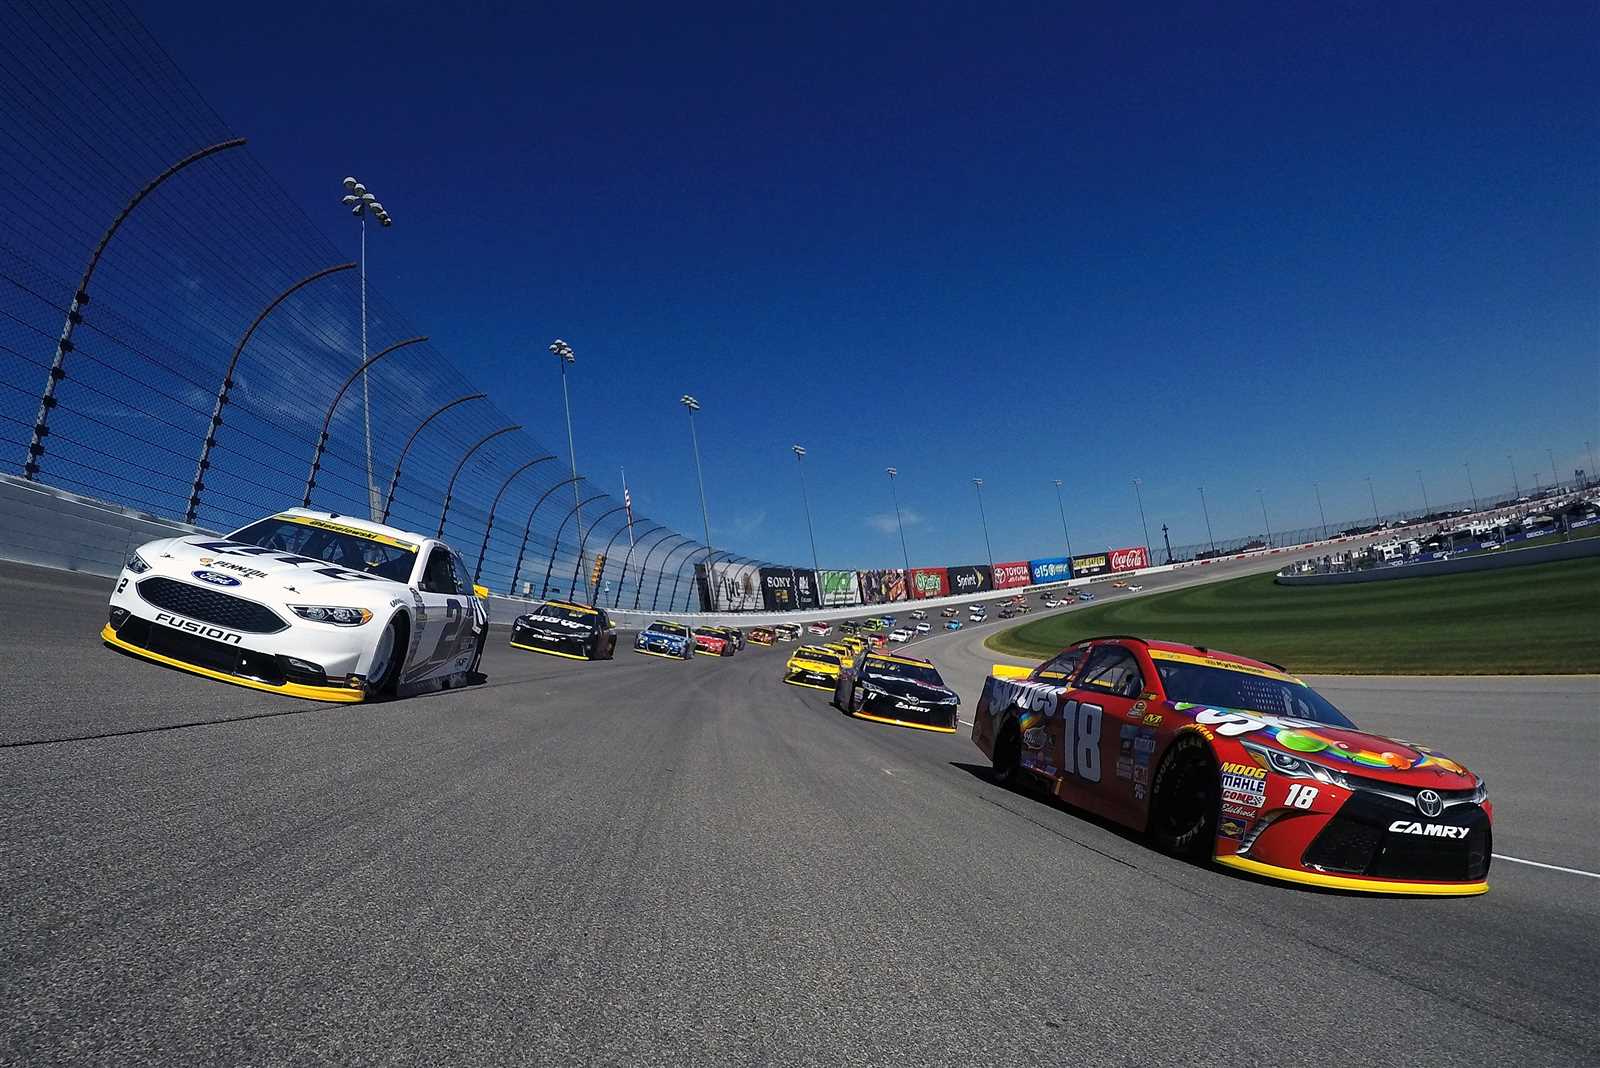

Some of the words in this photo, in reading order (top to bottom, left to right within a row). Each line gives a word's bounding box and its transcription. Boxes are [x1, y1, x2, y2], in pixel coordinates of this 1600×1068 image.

[199, 571, 233, 586] Ford
[213, 560, 269, 579] PENNZOIL
[1005, 566, 1028, 576] TOYOTA
[116, 577, 129, 594] 2
[767, 576, 791, 588] SONY
[956, 574, 977, 590] Sprint
[155, 612, 243, 644] FUSION
[430, 598, 464, 660] 2
[867, 692, 877, 700] 11
[1063, 700, 1103, 783] 18
[1221, 761, 1267, 779] MOOG
[1222, 774, 1265, 793] MAHLE
[1222, 790, 1254, 805] COMP
[1284, 783, 1319, 810] 18
[1388, 820, 1470, 839] CAMRY
